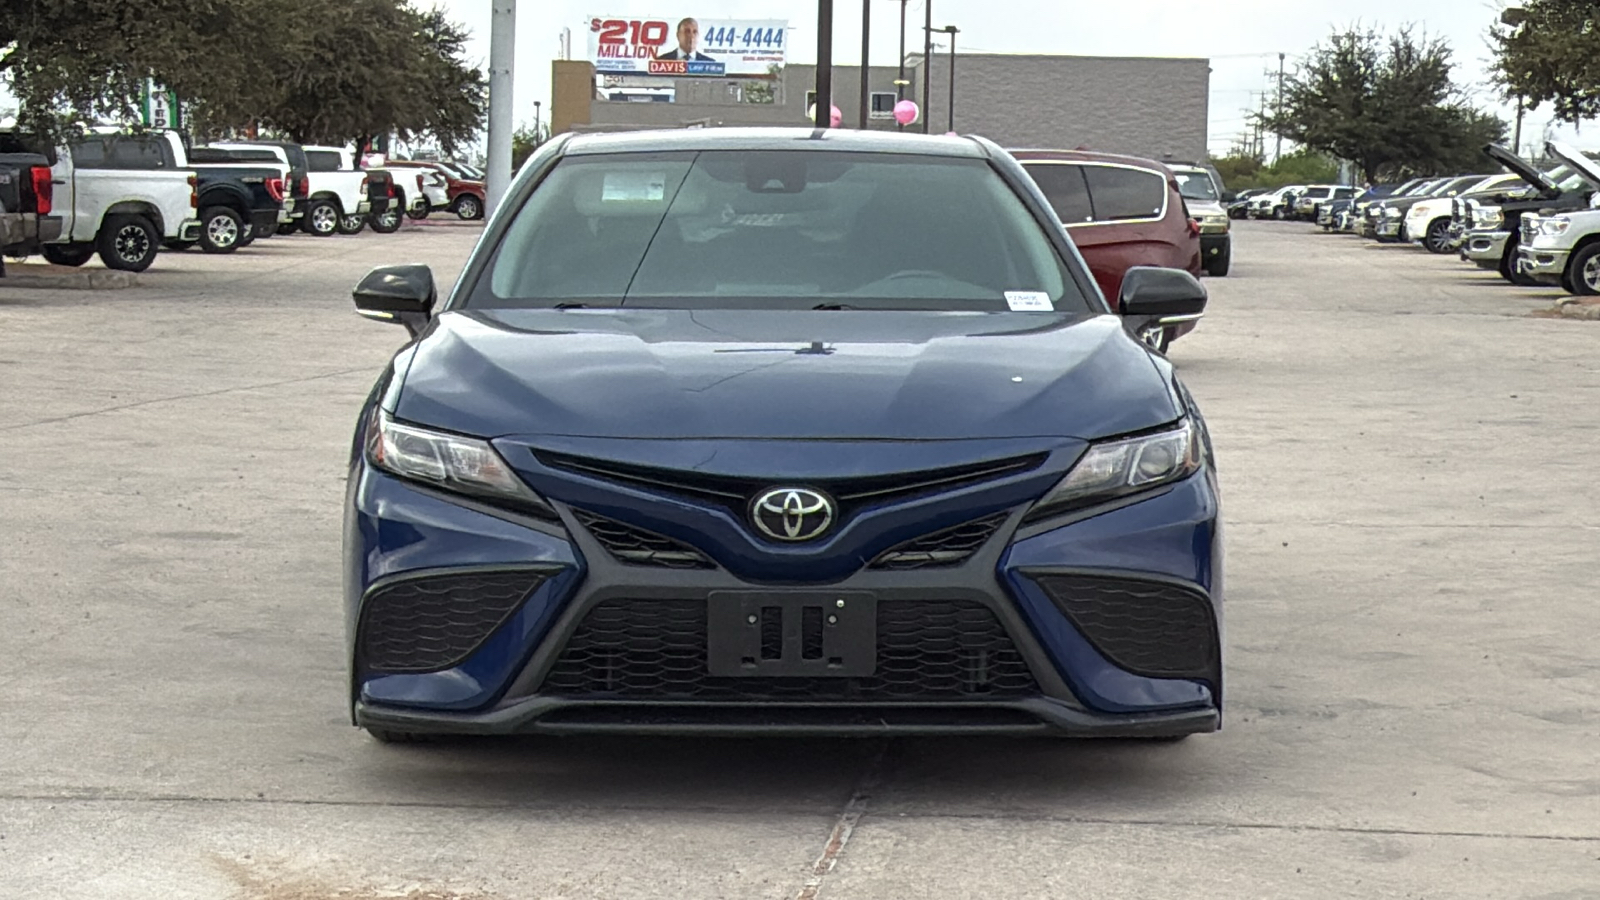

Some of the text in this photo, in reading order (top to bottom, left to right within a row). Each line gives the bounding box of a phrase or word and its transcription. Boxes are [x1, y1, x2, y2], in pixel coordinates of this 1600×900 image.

[590, 18, 668, 46] $210
[704, 26, 784, 48] 444-4444
[597, 45, 659, 59] MILLION
[650, 62, 686, 73] DAVIS
